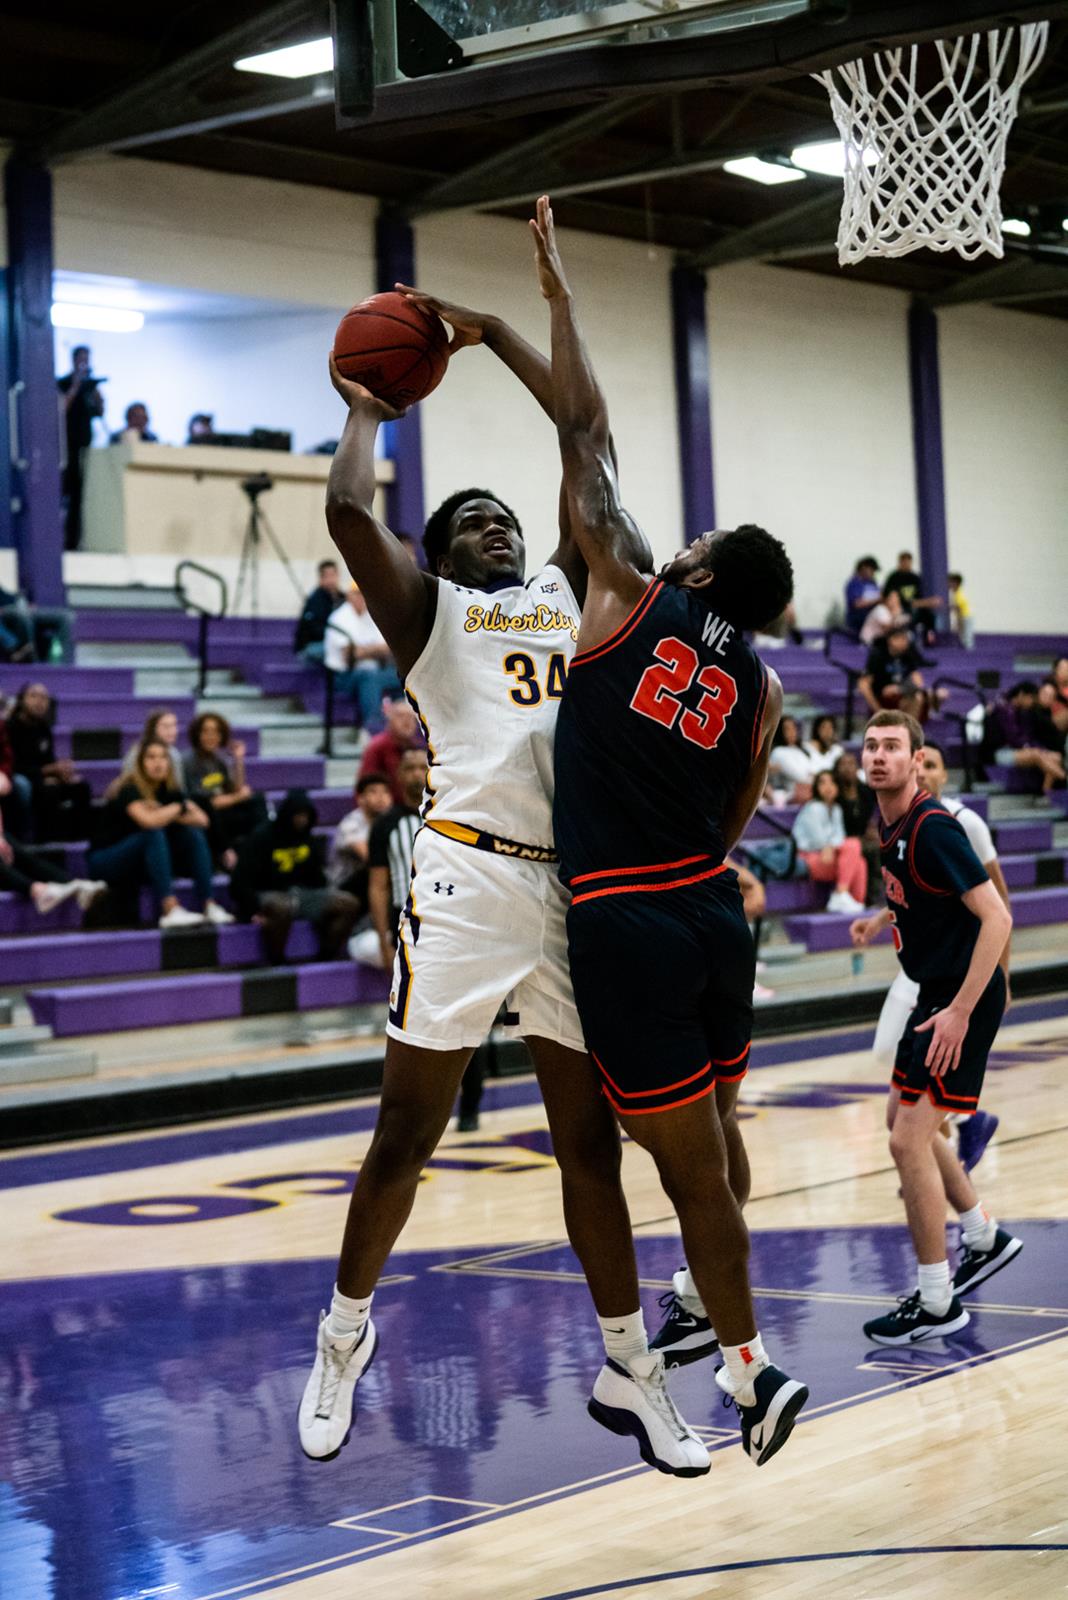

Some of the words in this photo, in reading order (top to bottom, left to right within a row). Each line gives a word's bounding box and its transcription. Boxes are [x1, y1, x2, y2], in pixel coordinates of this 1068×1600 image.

[540, 582, 559, 594] LSC
[701, 611, 735, 657] WE
[502, 650, 570, 708] 34
[629, 636, 739, 750] 23
